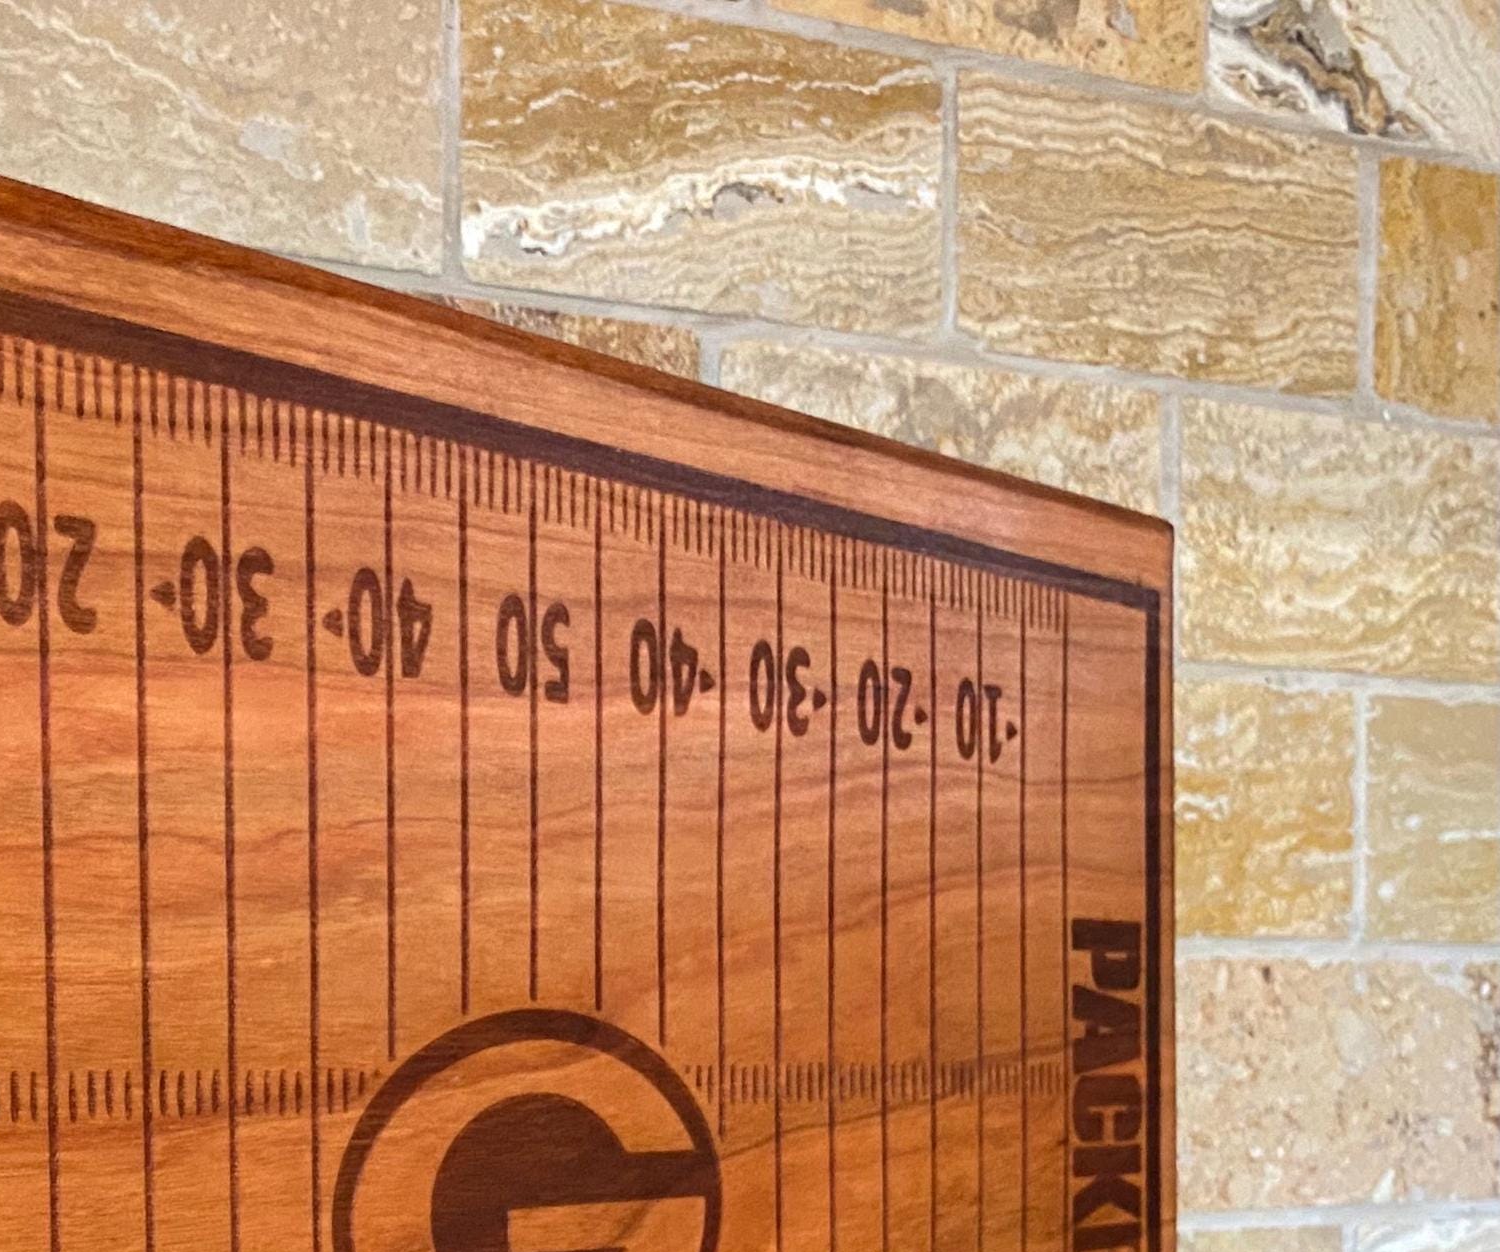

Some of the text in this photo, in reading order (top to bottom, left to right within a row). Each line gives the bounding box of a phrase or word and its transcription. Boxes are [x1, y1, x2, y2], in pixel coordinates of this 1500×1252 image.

[180, 536, 275, 661] 30
[347, 567, 433, 678] 40
[497, 593, 570, 704] 50
[629, 618, 699, 717] 40
[749, 640, 810, 736] 30
[857, 658, 912, 750] 20
[955, 676, 1003, 764] 10
